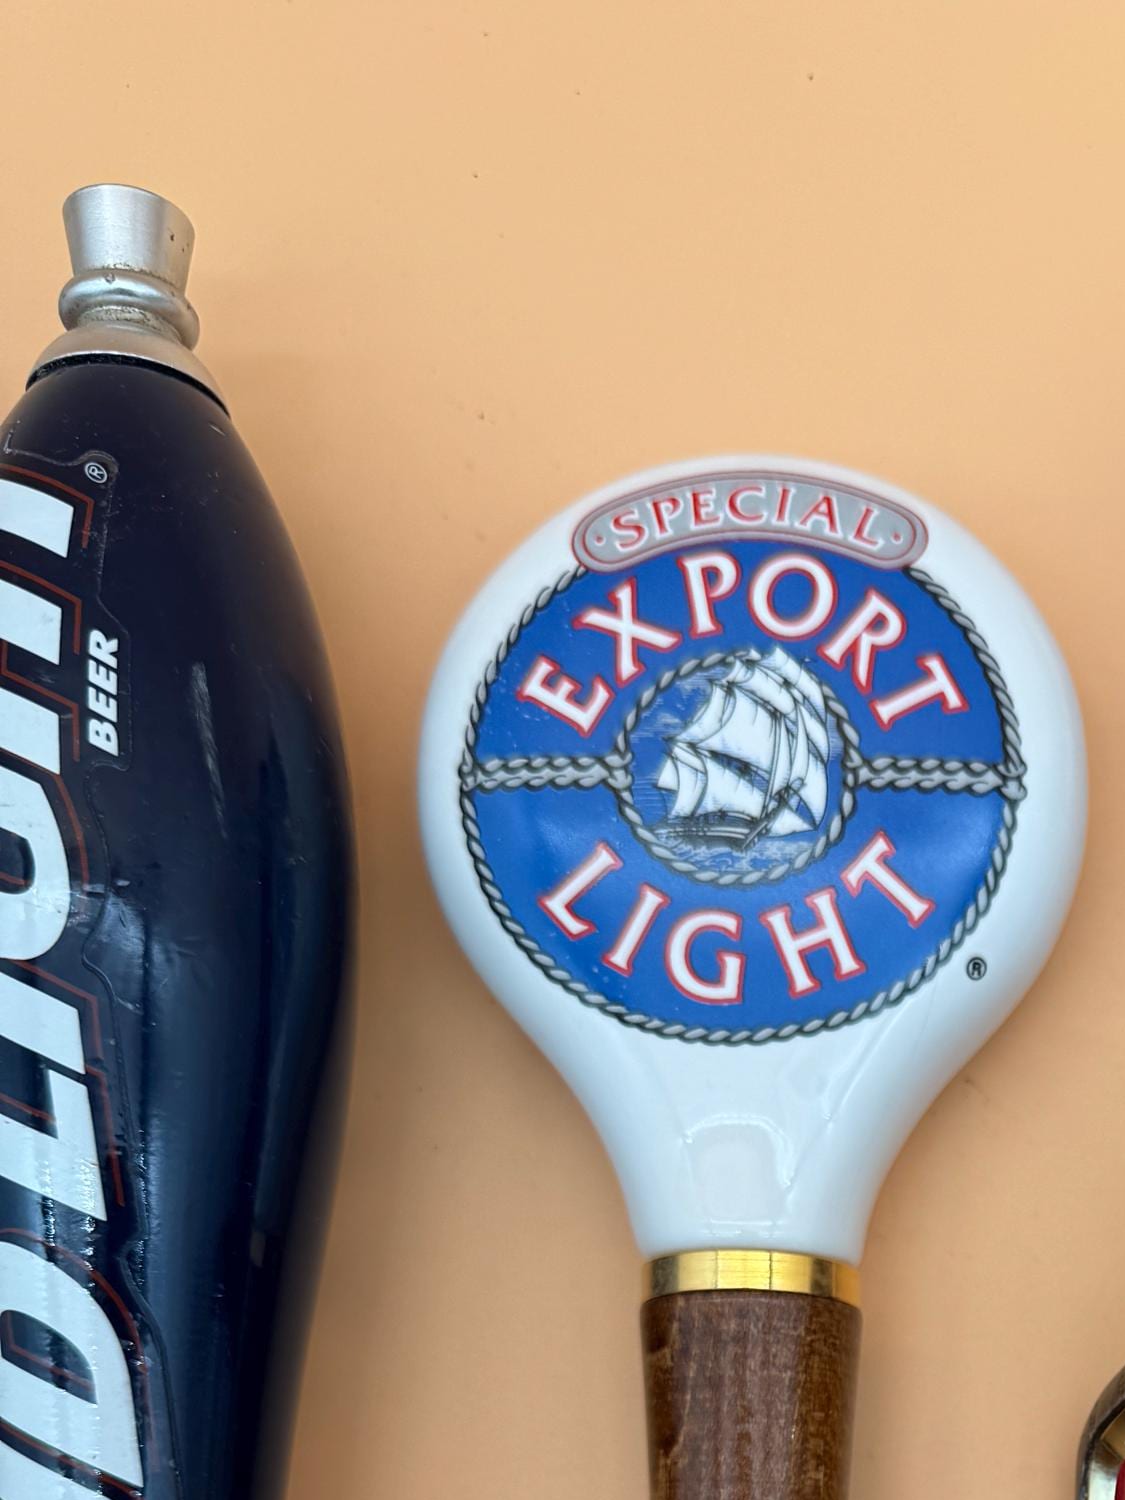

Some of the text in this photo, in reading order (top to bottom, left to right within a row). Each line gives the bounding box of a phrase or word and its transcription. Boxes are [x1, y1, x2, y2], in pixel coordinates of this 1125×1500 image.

[609, 481, 886, 552] SPECIAL
[88, 629, 119, 757] BEER
[517, 550, 969, 737] EXPORT
[538, 831, 936, 1005] LIGHT
